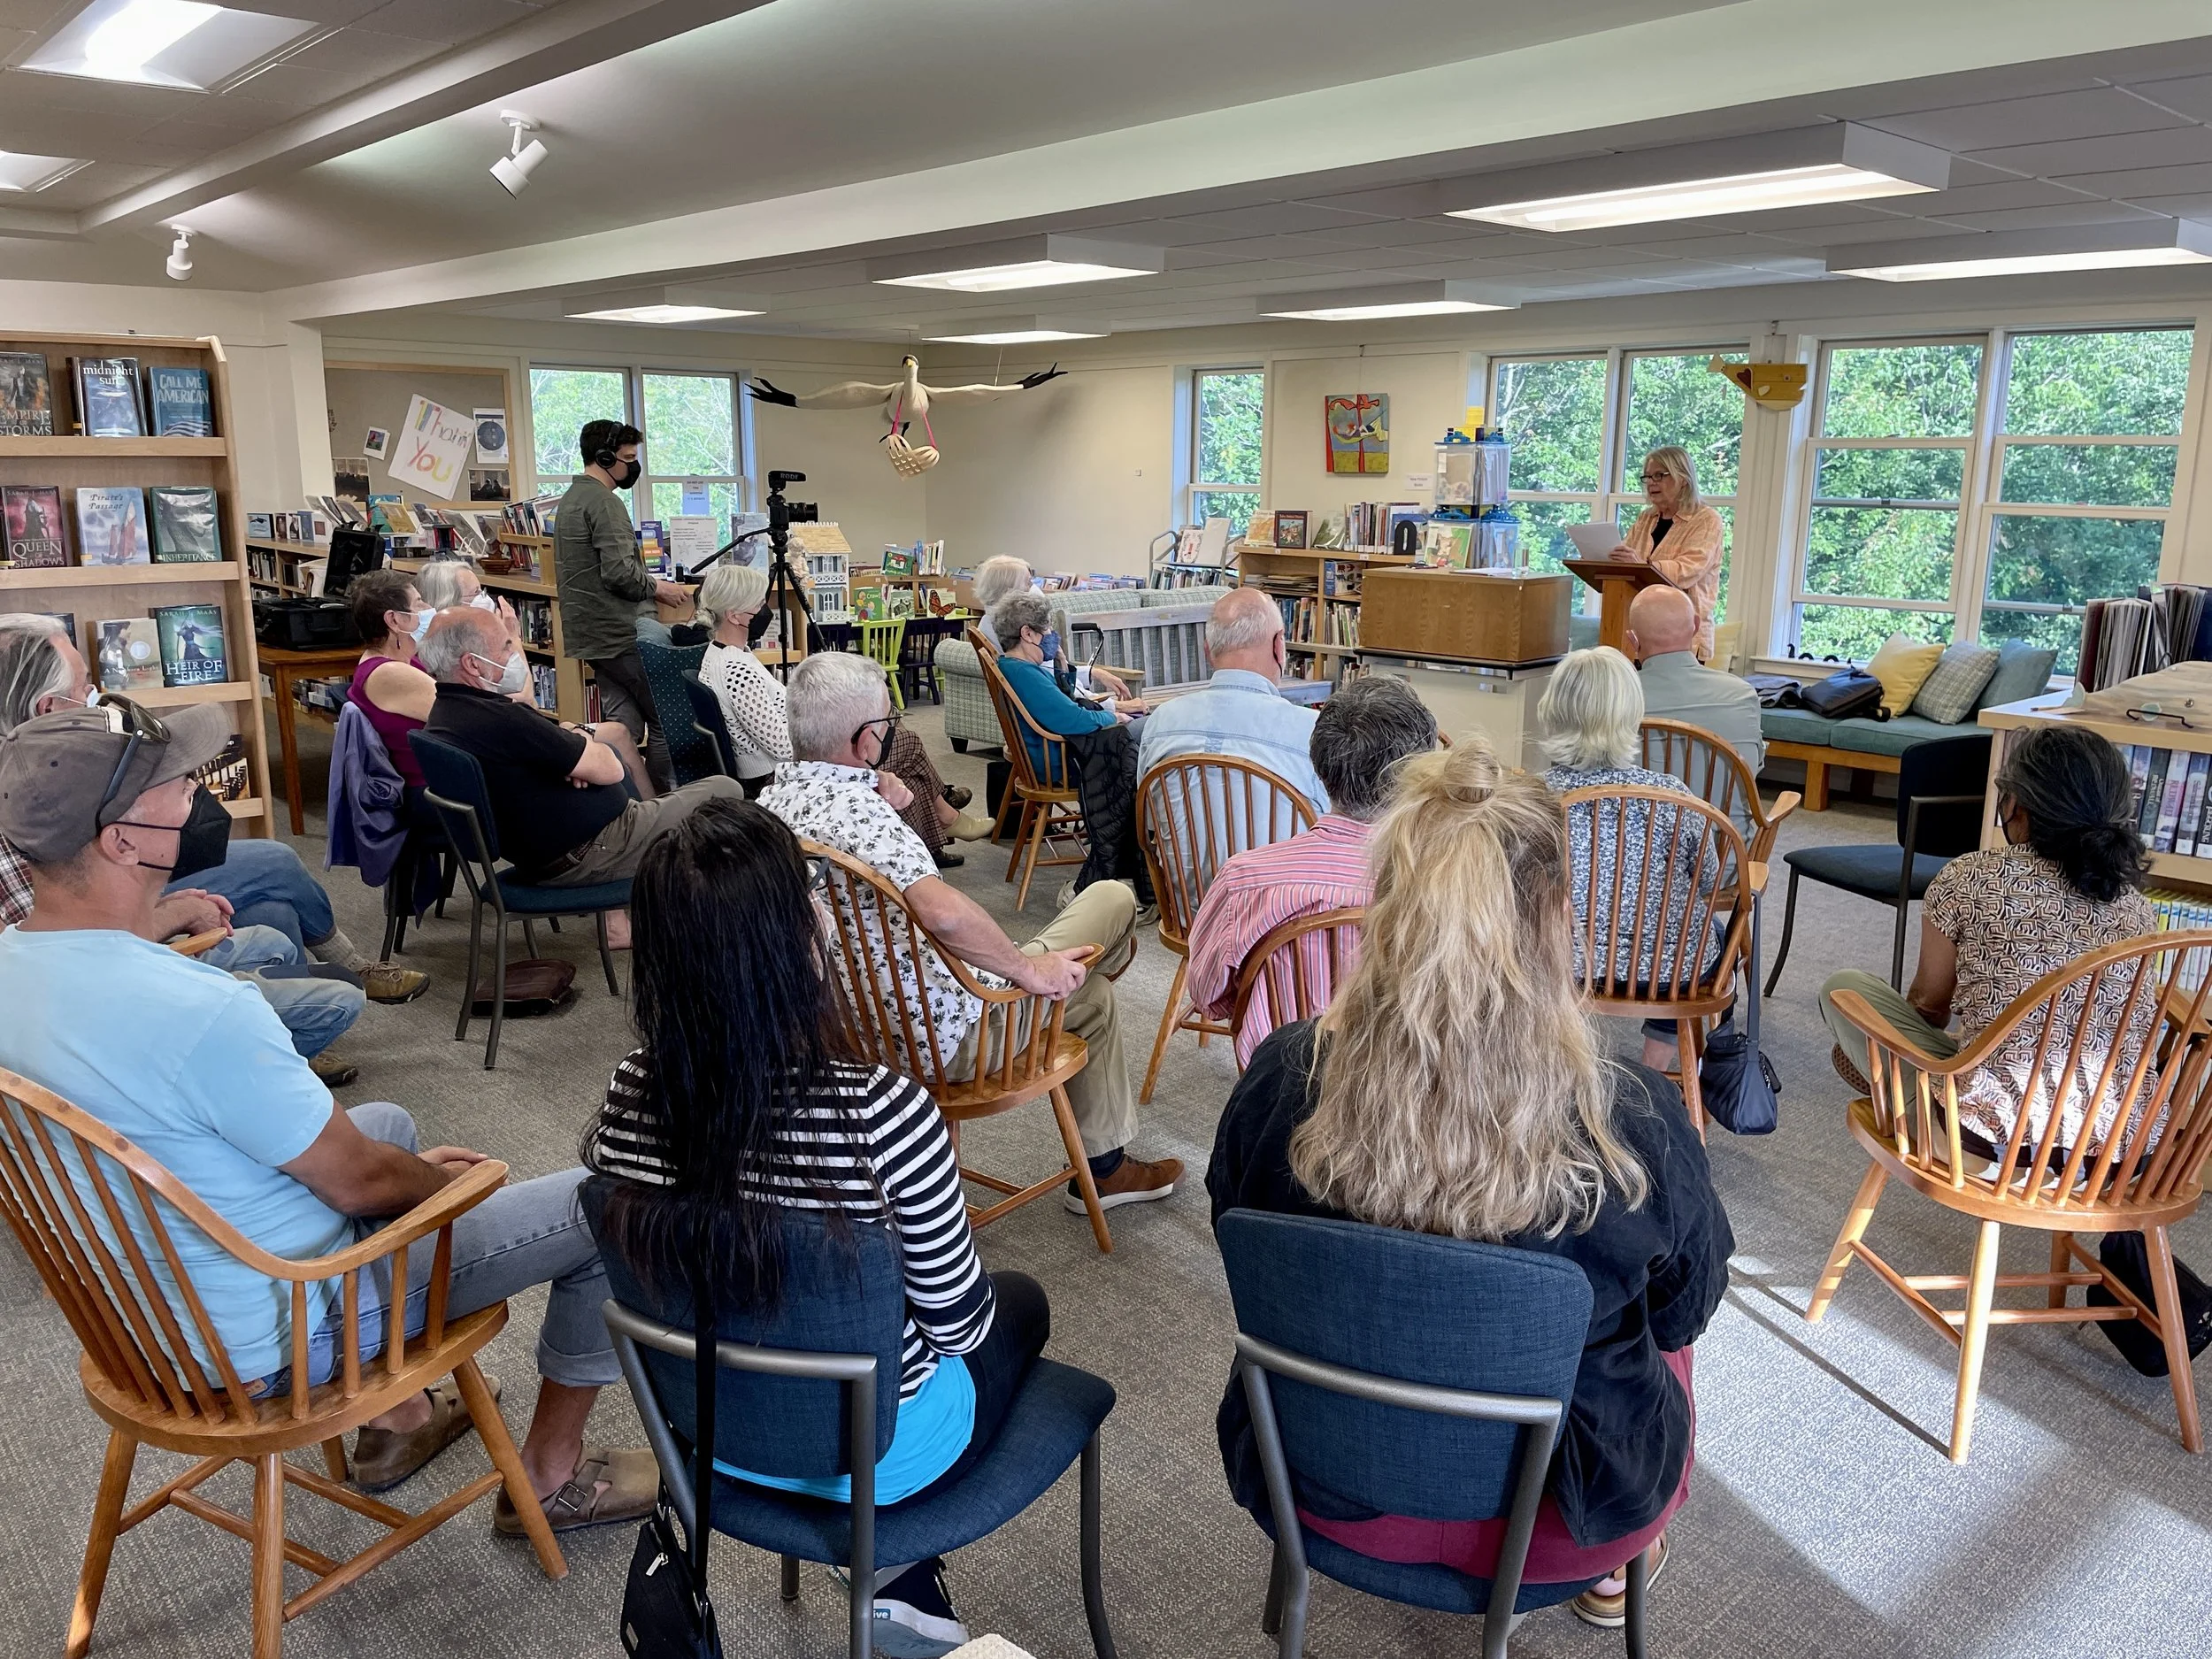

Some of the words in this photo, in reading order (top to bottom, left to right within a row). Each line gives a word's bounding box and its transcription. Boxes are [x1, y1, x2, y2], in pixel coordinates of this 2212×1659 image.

[83, 360, 134, 379] midnight
[159, 374, 181, 389] CALL
[186, 377, 203, 389] ME
[157, 389, 209, 404] AMERICAN
[0, 411, 51, 425] EMPIRE
[88, 503, 123, 511] Passage
[12, 540, 63, 560] QUEEN
[15, 557, 65, 568] SHADOWS
[162, 553, 217, 562] INHERITANCE
[165, 662, 199, 675] HEIR
[203, 660, 222, 673] OF
[180, 670, 213, 681] FIRE
[873, 1609, 888, 1618] ive
